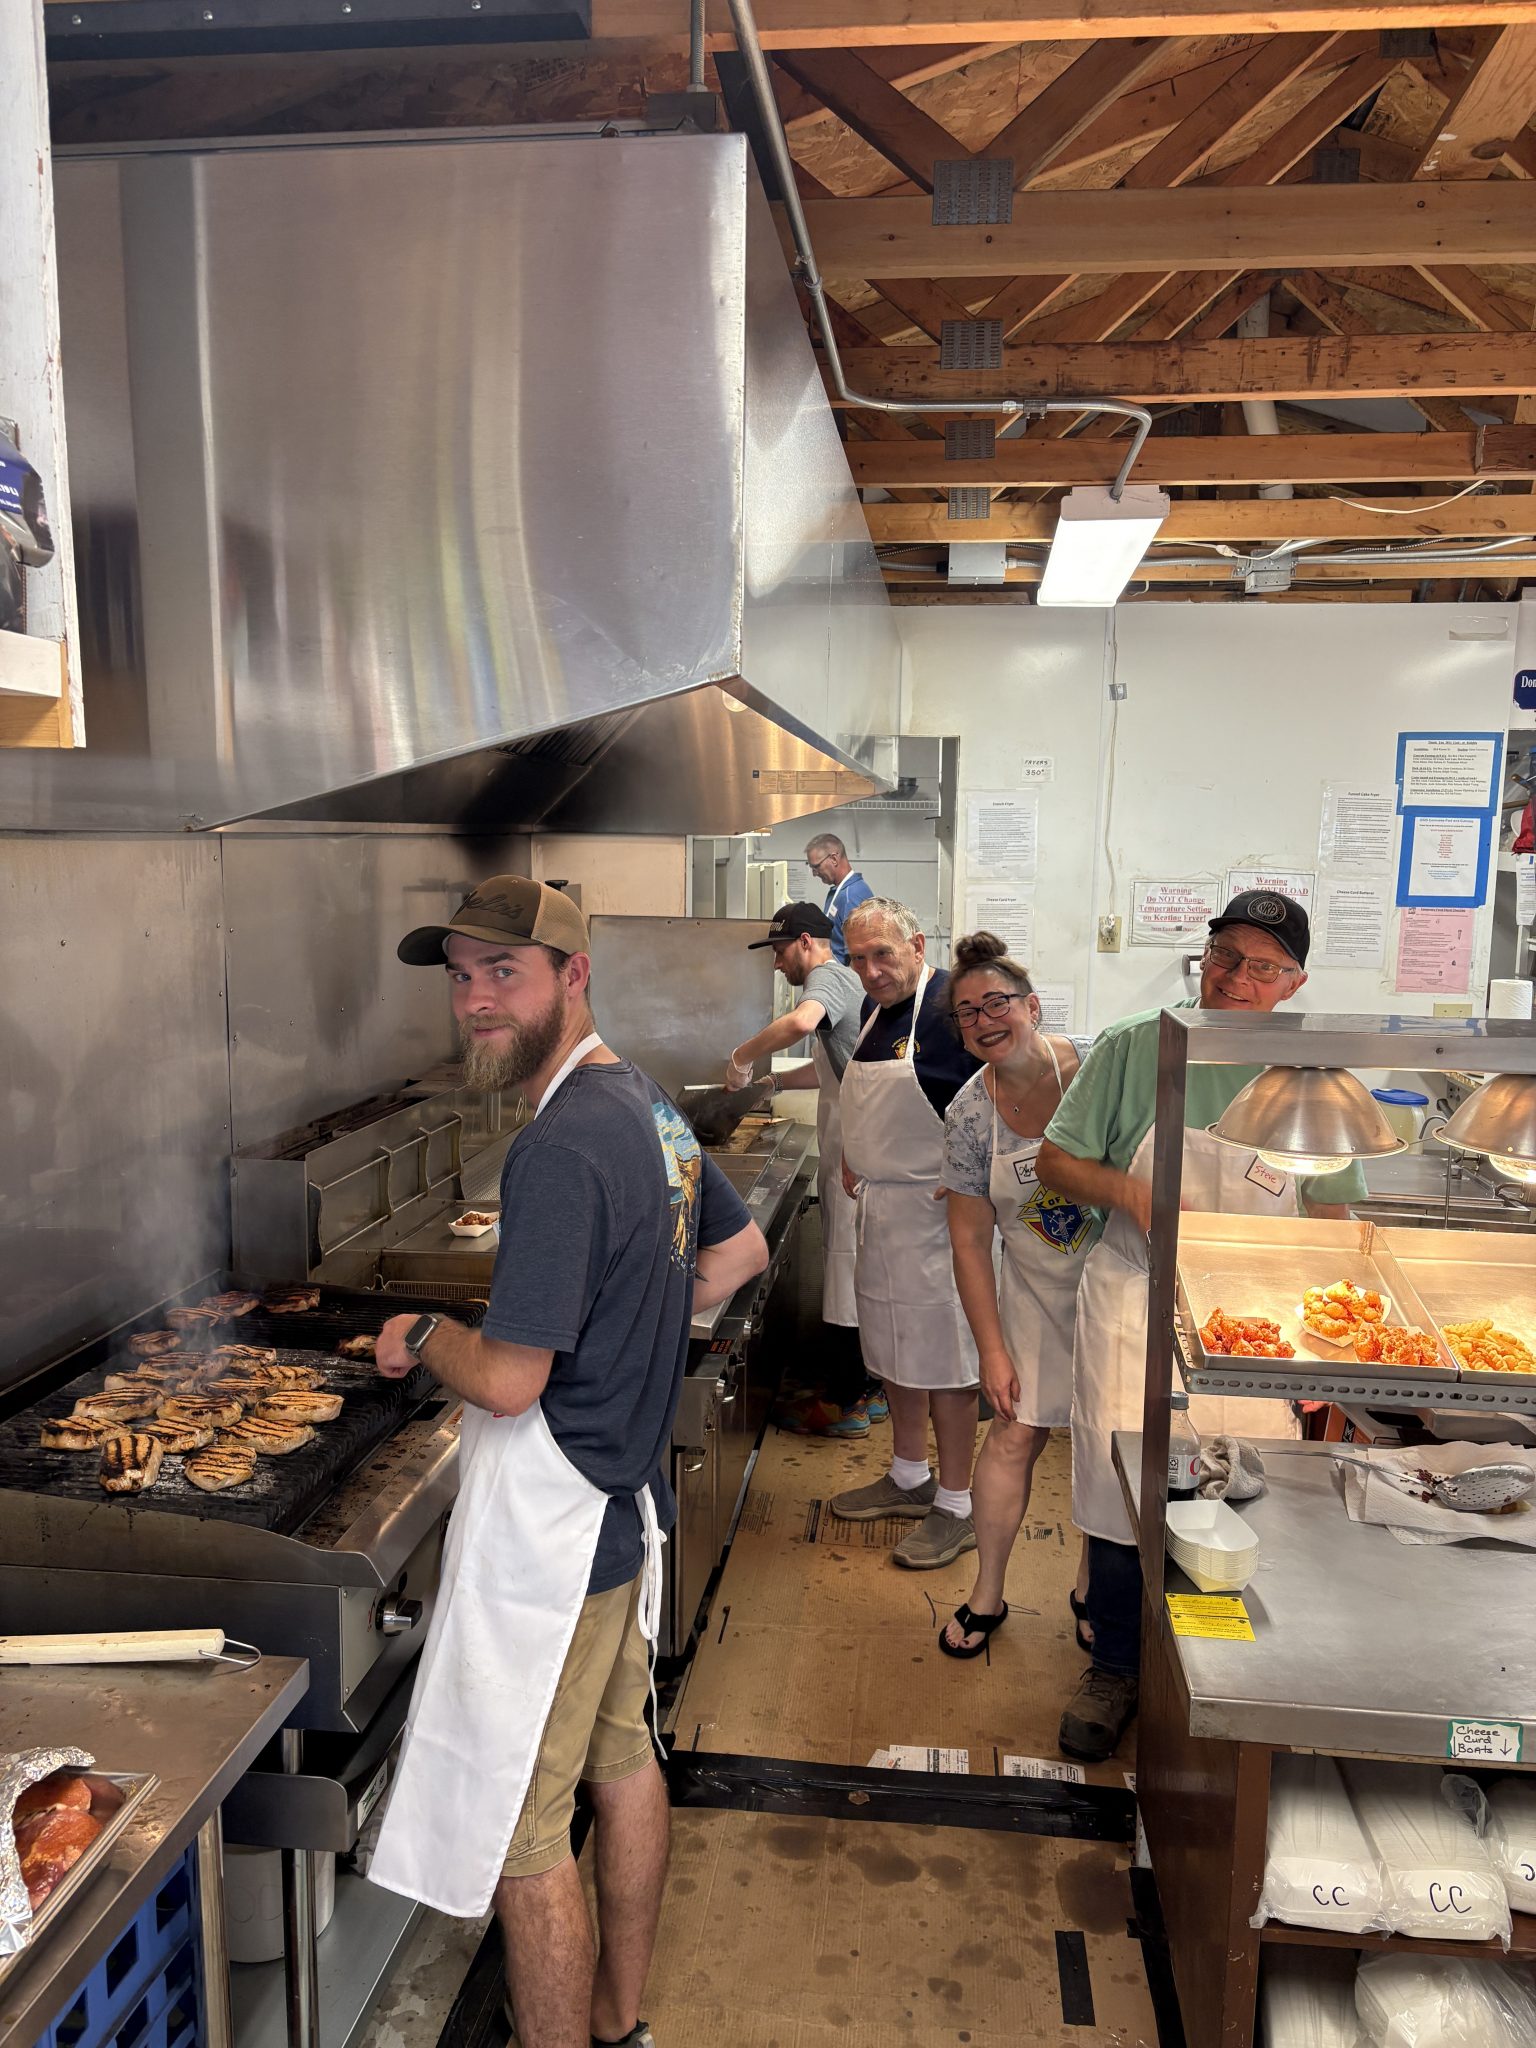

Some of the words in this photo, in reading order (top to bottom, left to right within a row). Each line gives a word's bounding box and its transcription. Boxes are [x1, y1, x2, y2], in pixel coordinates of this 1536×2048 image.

[1255, 876, 1288, 886] Warning
[1160, 886, 1192, 895] Warning
[1260, 886, 1309, 895] OVERLOAD
[1178, 896, 1206, 904] Change
[1139, 905, 1186, 913] Temperature
[1187, 905, 1212, 914] Setting
[1154, 914, 1182, 922] Keating
[1255, 1165, 1277, 1184] Steve
[1456, 1725, 1501, 1737] Cheese
[1463, 1735, 1492, 1744] Curd
[1312, 1884, 1350, 1907] CC
[1429, 1882, 1472, 1914] CC
